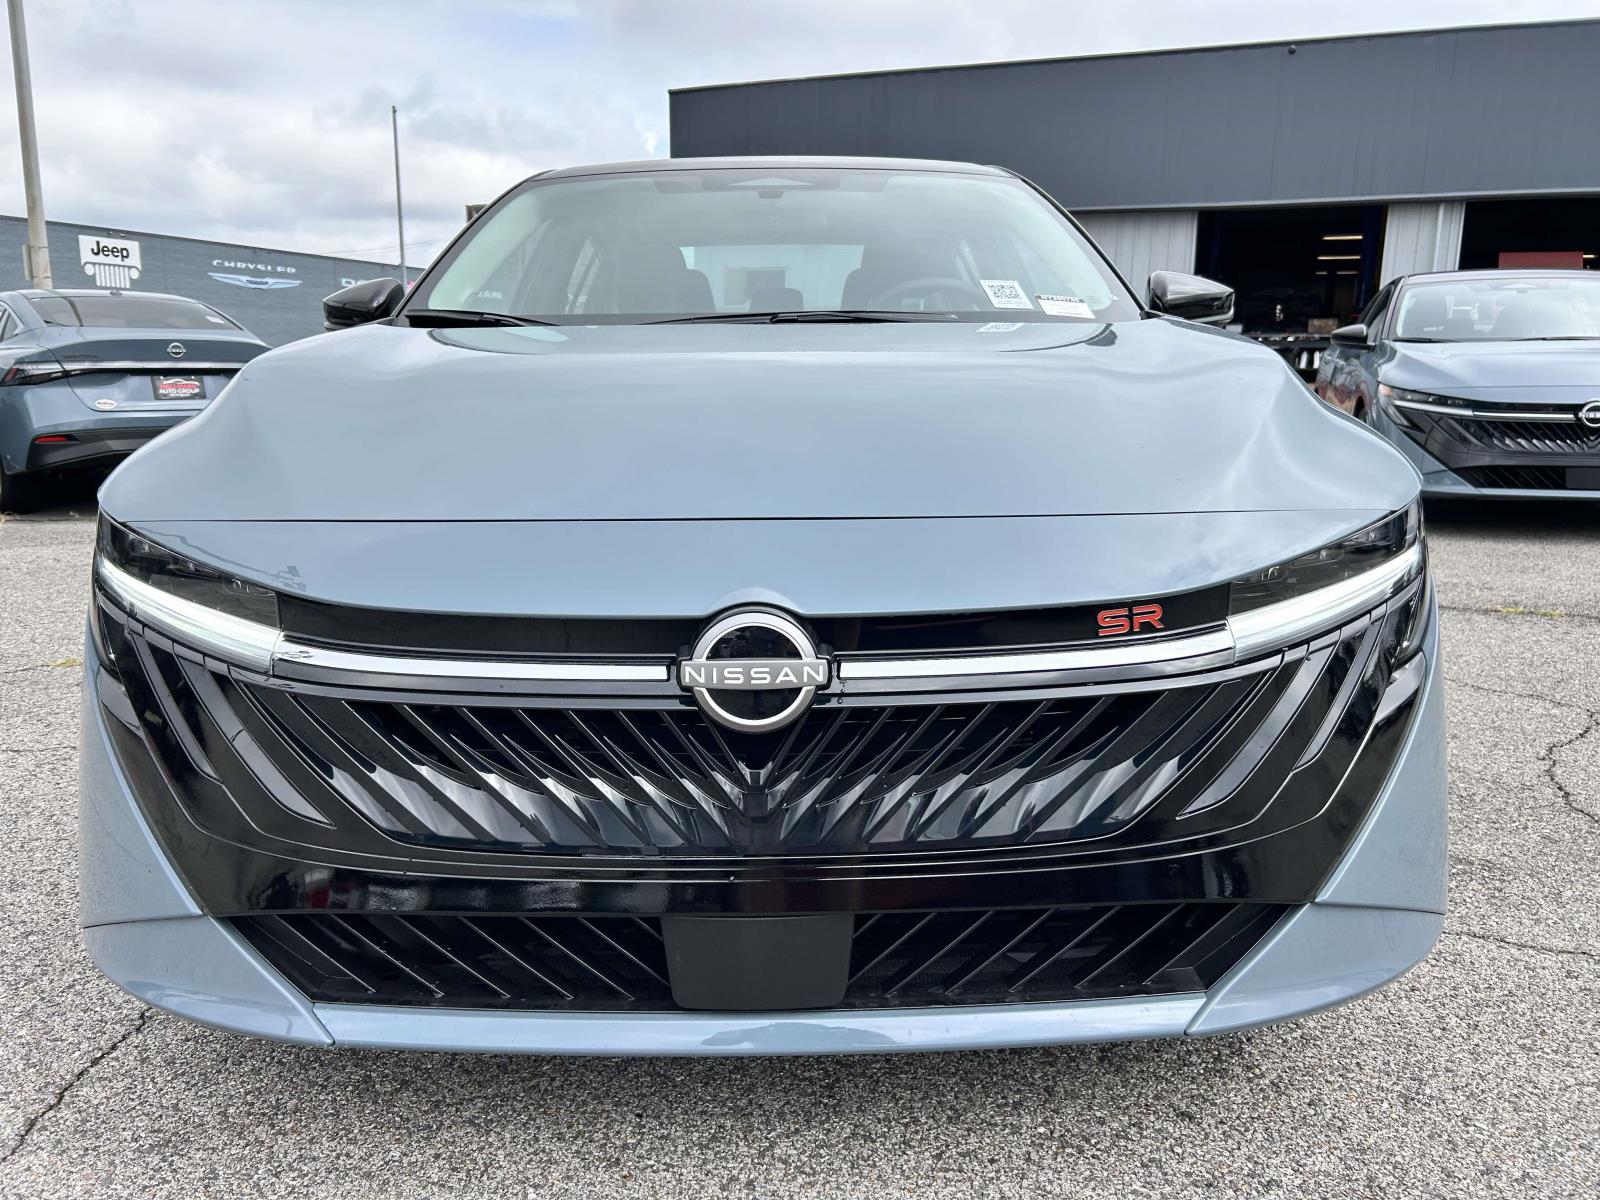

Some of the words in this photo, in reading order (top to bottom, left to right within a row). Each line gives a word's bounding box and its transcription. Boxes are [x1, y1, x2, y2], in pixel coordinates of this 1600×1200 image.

[91, 241, 130, 262] Jeep
[212, 259, 296, 273] CHRYSLER
[1097, 604, 1165, 636] SR
[684, 665, 824, 685] NISSAN
